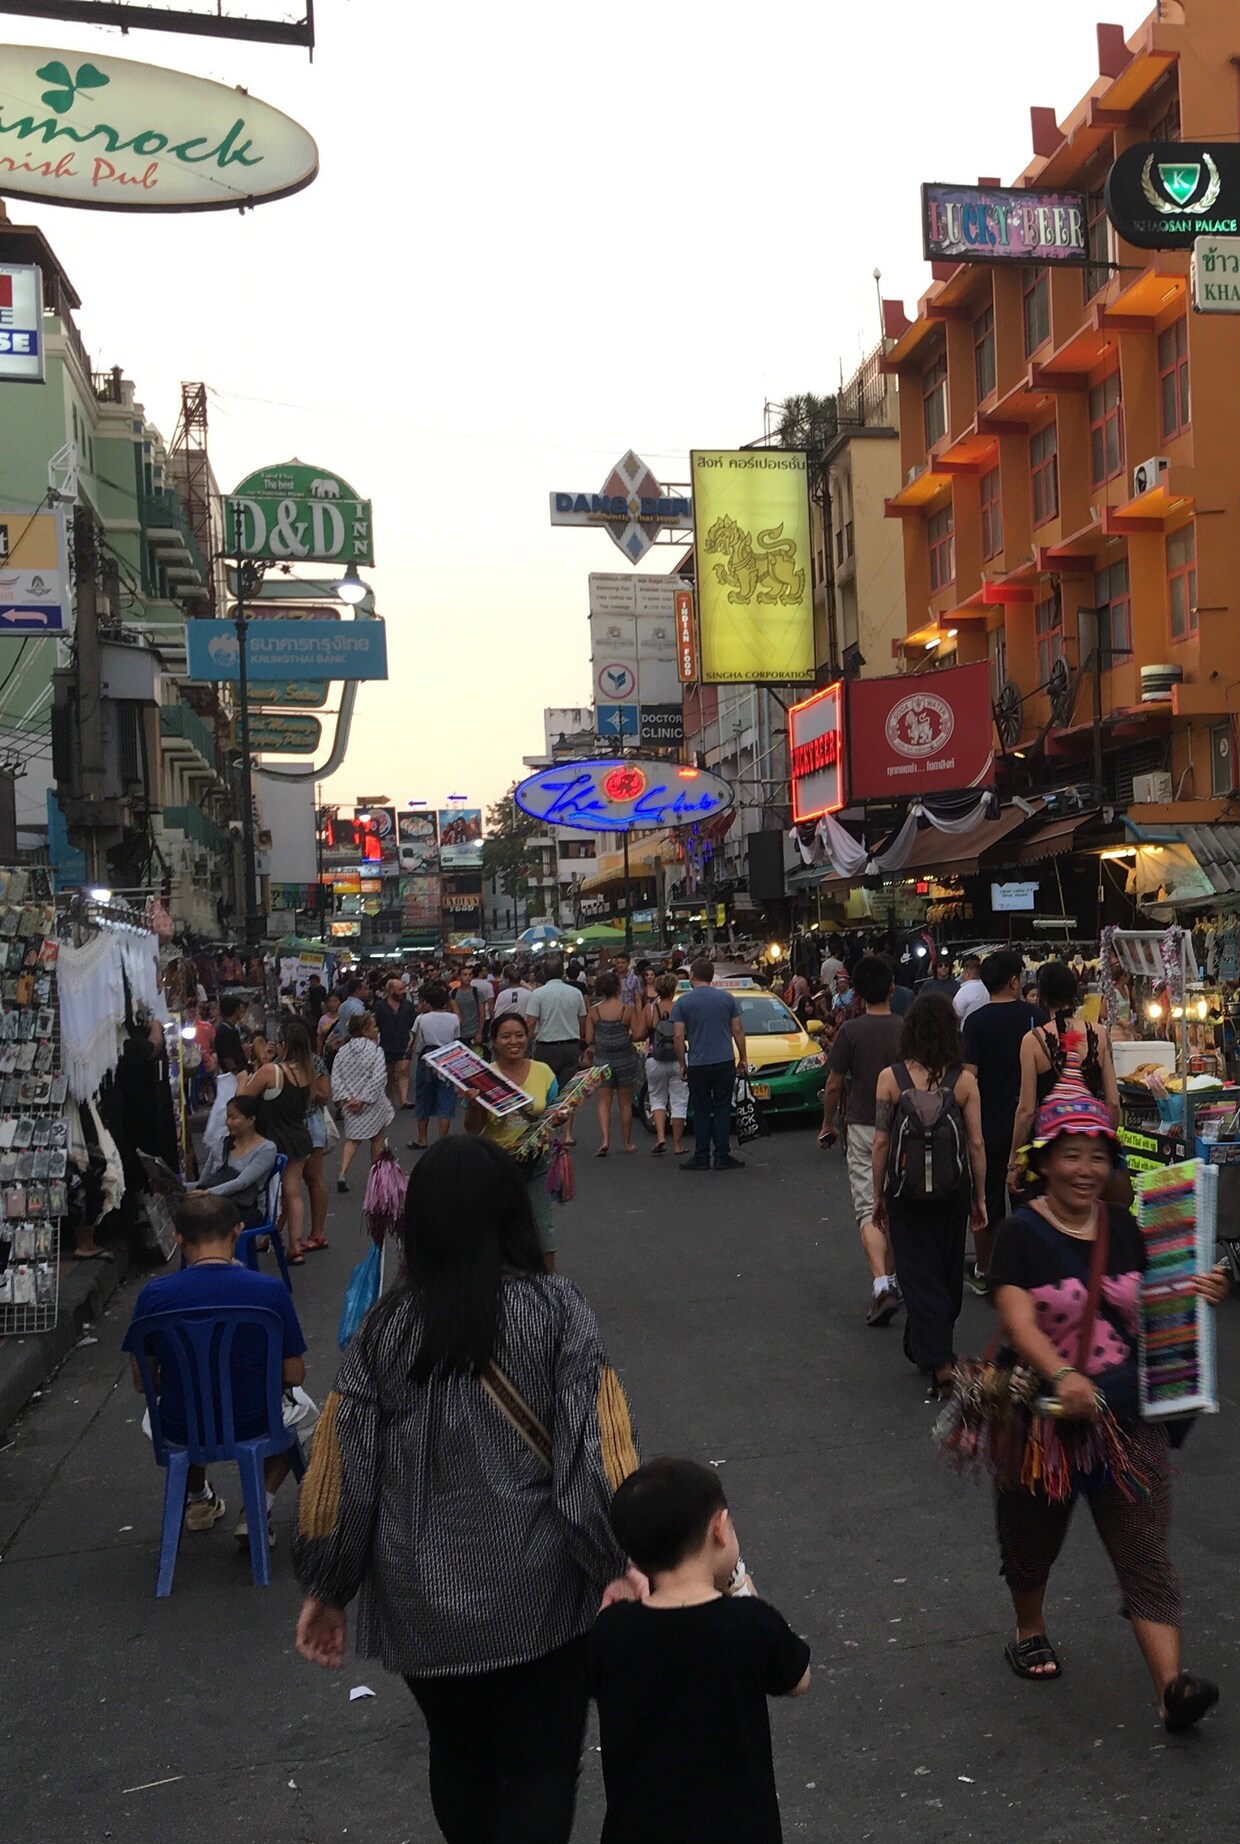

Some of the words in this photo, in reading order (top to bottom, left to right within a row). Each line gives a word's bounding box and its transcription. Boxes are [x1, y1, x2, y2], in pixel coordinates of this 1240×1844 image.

[0, 152, 79, 178] rish
[91, 158, 160, 190] Pub
[929, 202, 1010, 247] LUCKY
[1020, 206, 1085, 248] BEER
[1133, 220, 1192, 232] KHAOSAN
[1194, 219, 1238, 232] PALACE
[697, 456, 724, 469] สิงห์
[556, 493, 628, 514] DANG
[228, 500, 346, 558] D&D
[352, 503, 369, 556] INN
[681, 601, 689, 643] INDIAN
[250, 635, 370, 654] ธนาคารกรุงไทย
[250, 655, 314, 664] KRUNGTHAI
[316, 655, 346, 664] BANK
[683, 648, 692, 676] FOOD
[705, 671, 743, 680] SINGHA
[745, 670, 815, 680] CORPORATION
[641, 714, 683, 723] DOCTOR
[642, 727, 684, 739] CLINIC
[540, 774, 608, 819] The
[633, 785, 722, 814] Club
